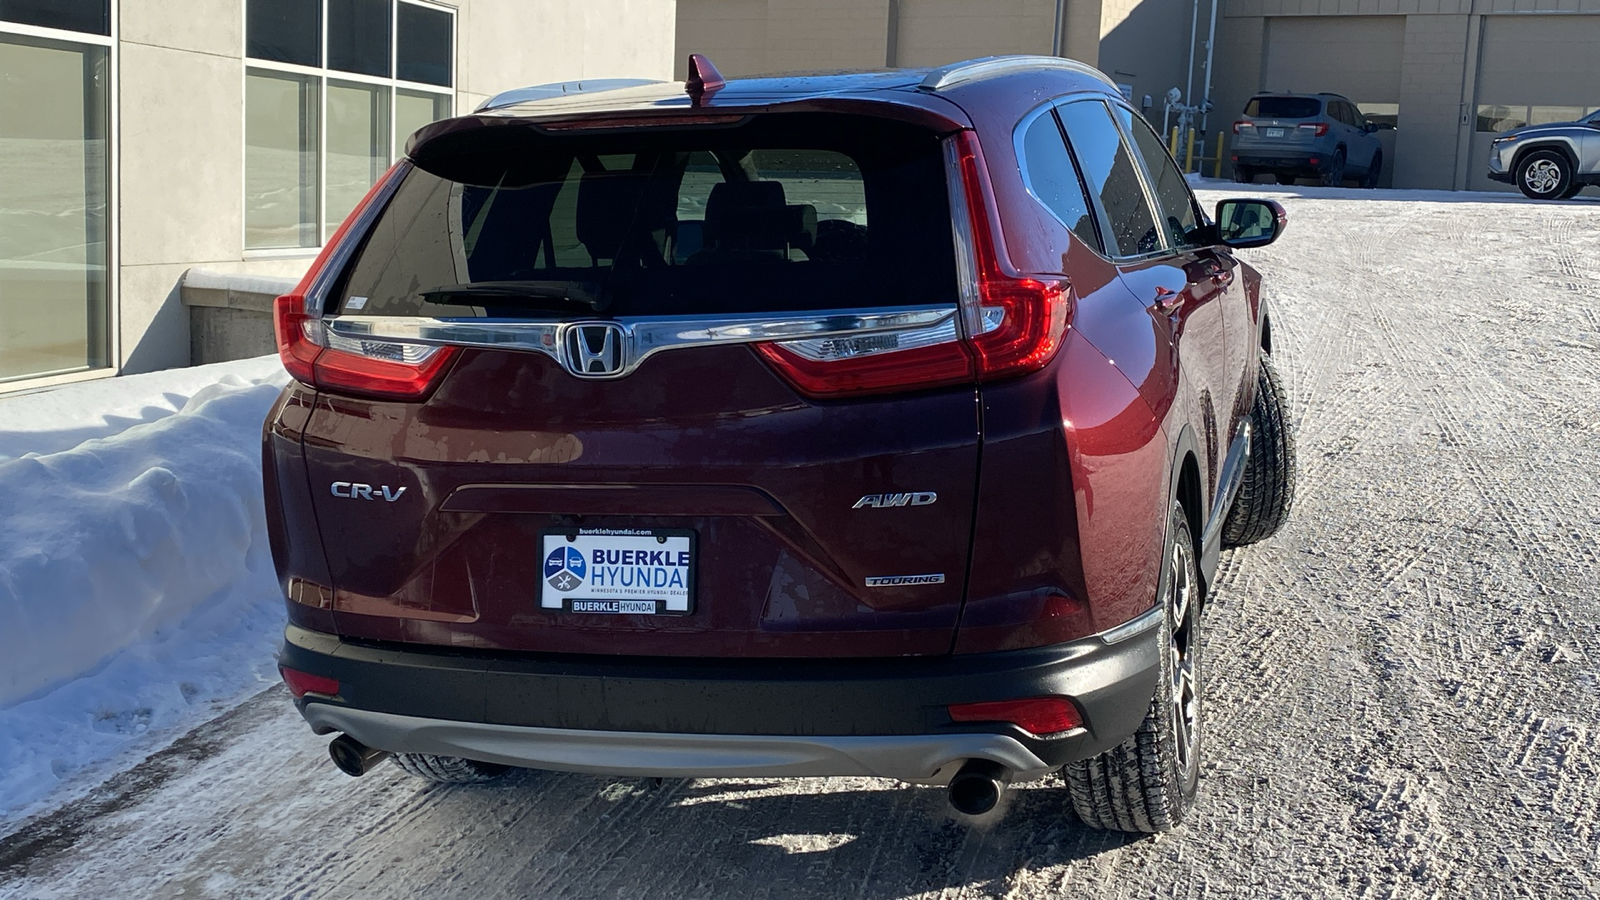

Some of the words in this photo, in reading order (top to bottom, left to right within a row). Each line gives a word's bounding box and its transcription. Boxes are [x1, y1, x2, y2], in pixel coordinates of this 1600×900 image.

[330, 481, 407, 502] CR-V
[851, 491, 938, 509] AWD
[579, 528, 652, 536] buerklehyundai.com
[592, 549, 690, 567] BUERKLE
[870, 575, 940, 586] TOURING
